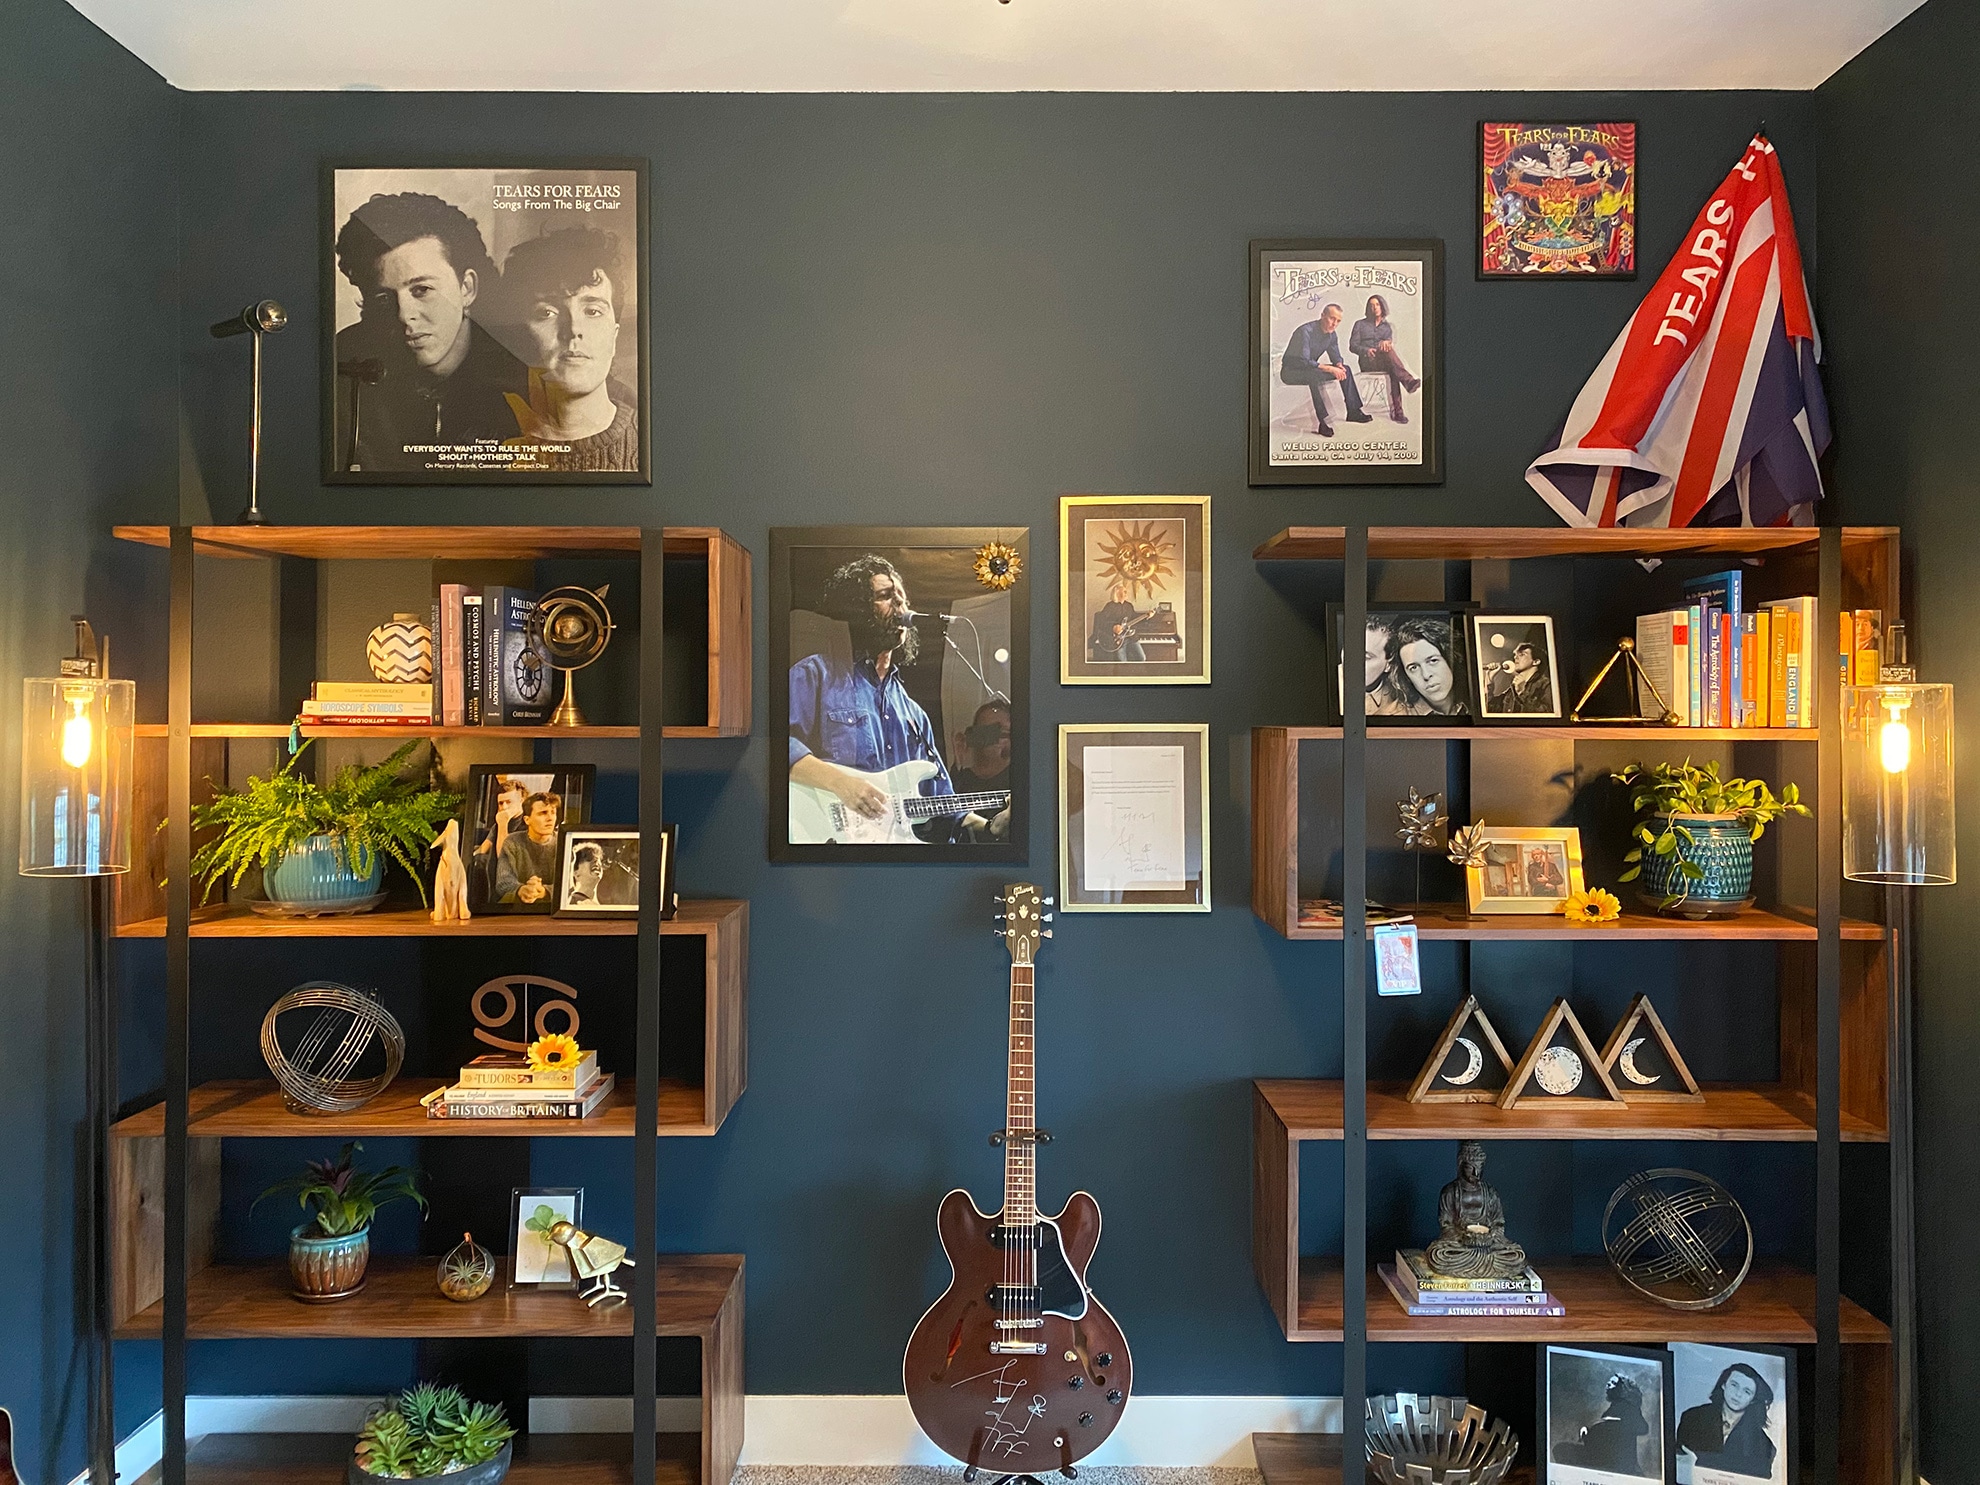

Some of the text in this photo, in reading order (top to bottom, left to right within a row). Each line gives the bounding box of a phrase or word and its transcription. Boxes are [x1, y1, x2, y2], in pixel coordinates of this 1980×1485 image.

[1496, 128, 1551, 148] TEARS
[1566, 126, 1620, 150] FEARS
[493, 185, 621, 198] TEARS FOR FEARS
[493, 199, 621, 212] Songs From The Big Chair
[1653, 199, 1734, 348] TEARS
[1274, 268, 1338, 302] TEARS
[1338, 272, 1359, 282] FOR
[1354, 266, 1417, 295] FEARS
[1282, 442, 1408, 451] WELLS FARGO CENTER
[1302, 453, 1328, 461] Rosa,
[1354, 452, 1374, 461] July
[1377, 452, 1391, 461] 14,
[1710, 648, 1720, 682] Astrology
[321, 704, 403, 712] HOROSCOPE SYMBOLS
[476, 1074, 516, 1084] TUDORS
[450, 1106, 502, 1115] HISTORY
[511, 1106, 559, 1115] BRITAIN
[1472, 1281, 1485, 1289] THE
[1486, 1281, 1509, 1289] INNER
[1510, 1281, 1525, 1290] SKY
[1506, 1307, 1539, 1315] YOURSELF
